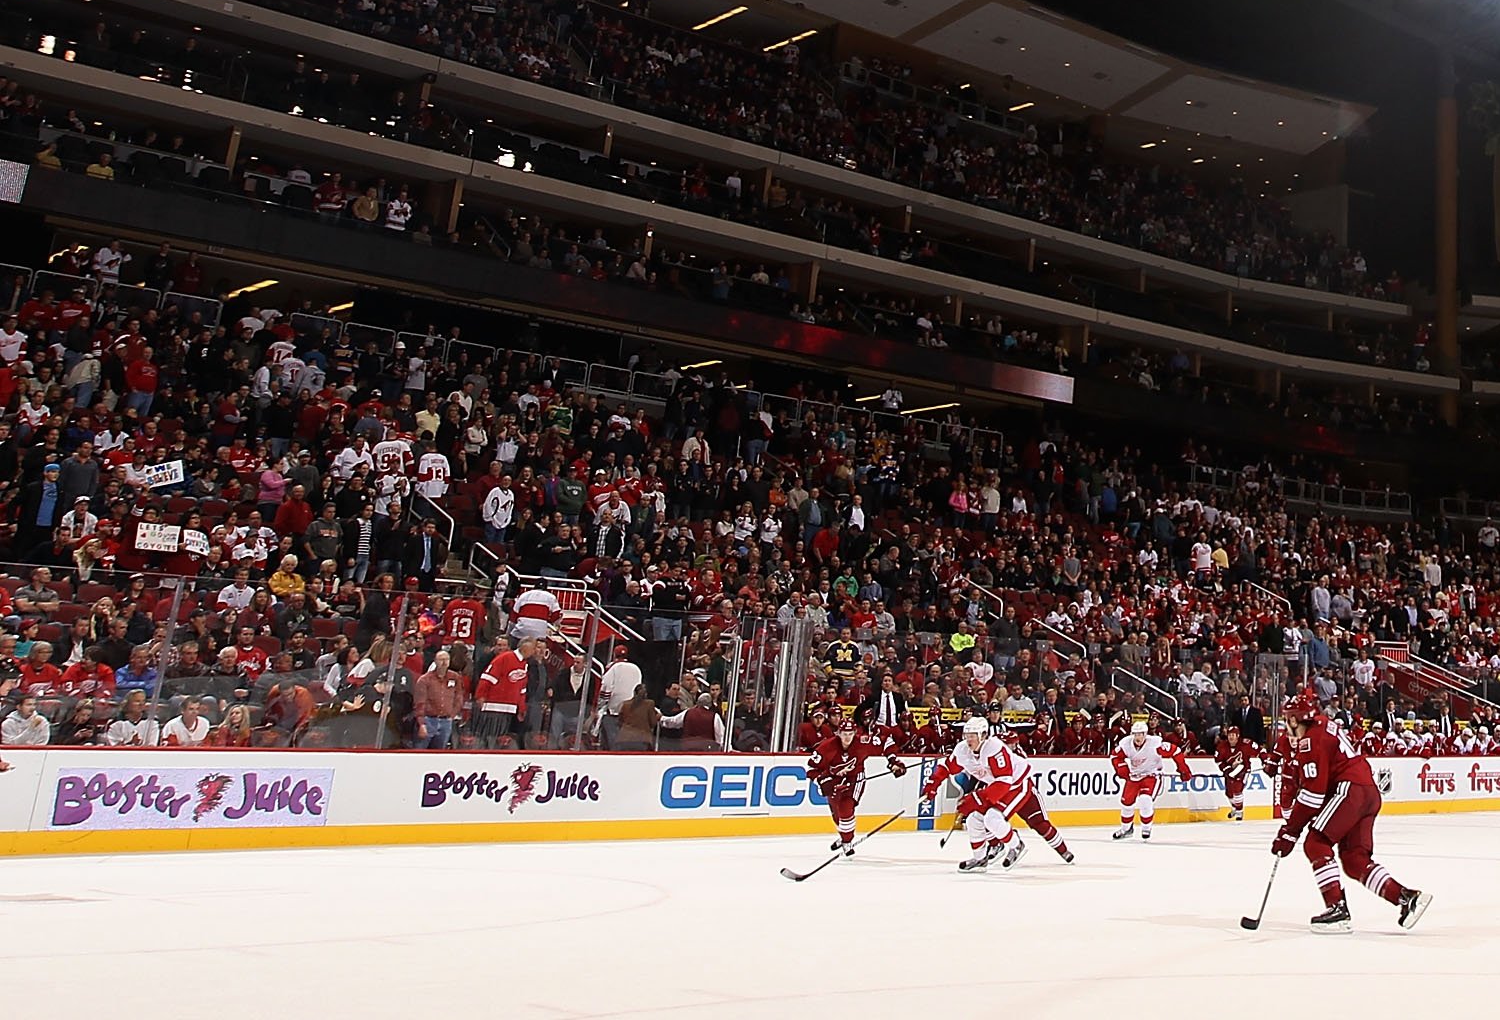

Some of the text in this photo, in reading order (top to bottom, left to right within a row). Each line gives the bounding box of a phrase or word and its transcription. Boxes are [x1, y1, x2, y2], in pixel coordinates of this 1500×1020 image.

[431, 466, 445, 481] 13
[136, 542, 177, 551] COYOTES
[451, 617, 473, 638] 13
[836, 649, 853, 662] M
[1302, 761, 1318, 779] 16
[1417, 763, 1456, 795] fry's
[420, 770, 600, 809] Booster Juice
[1046, 770, 1121, 796] SCHOOLS
[1167, 773, 1268, 793] HONA
[52, 771, 326, 826] Booster Juice
